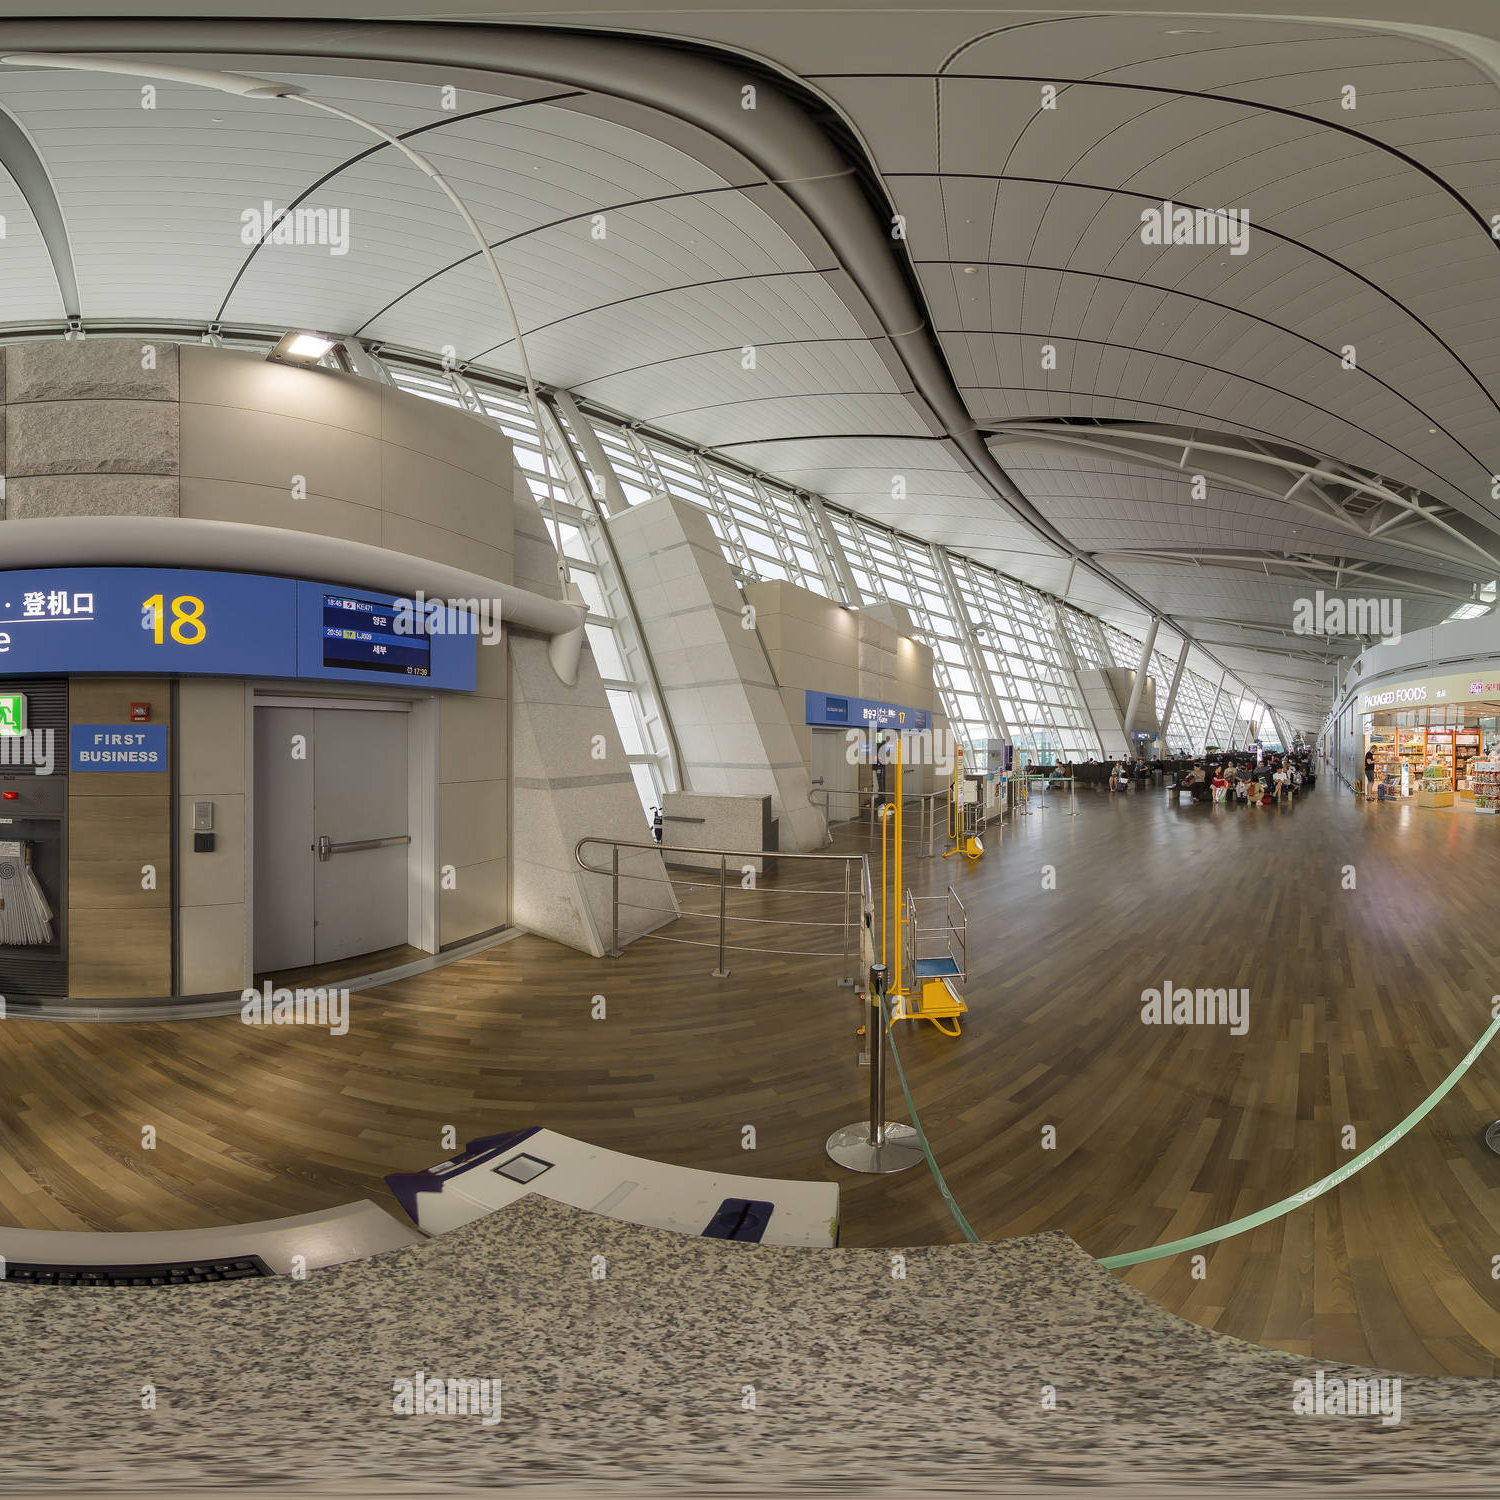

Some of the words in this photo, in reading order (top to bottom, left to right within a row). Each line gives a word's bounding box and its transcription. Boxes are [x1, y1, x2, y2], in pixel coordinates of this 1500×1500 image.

[142, 594, 206, 645] 18
[1364, 691, 1395, 708] PACKAGED
[1396, 686, 1428, 702] FOODS
[900, 712, 906, 724] 17
[94, 734, 146, 745] FIRST
[80, 751, 158, 762] BUSINESS
[1331, 1156, 1371, 1186] Incheon
[1372, 1131, 1402, 1156] Airport
